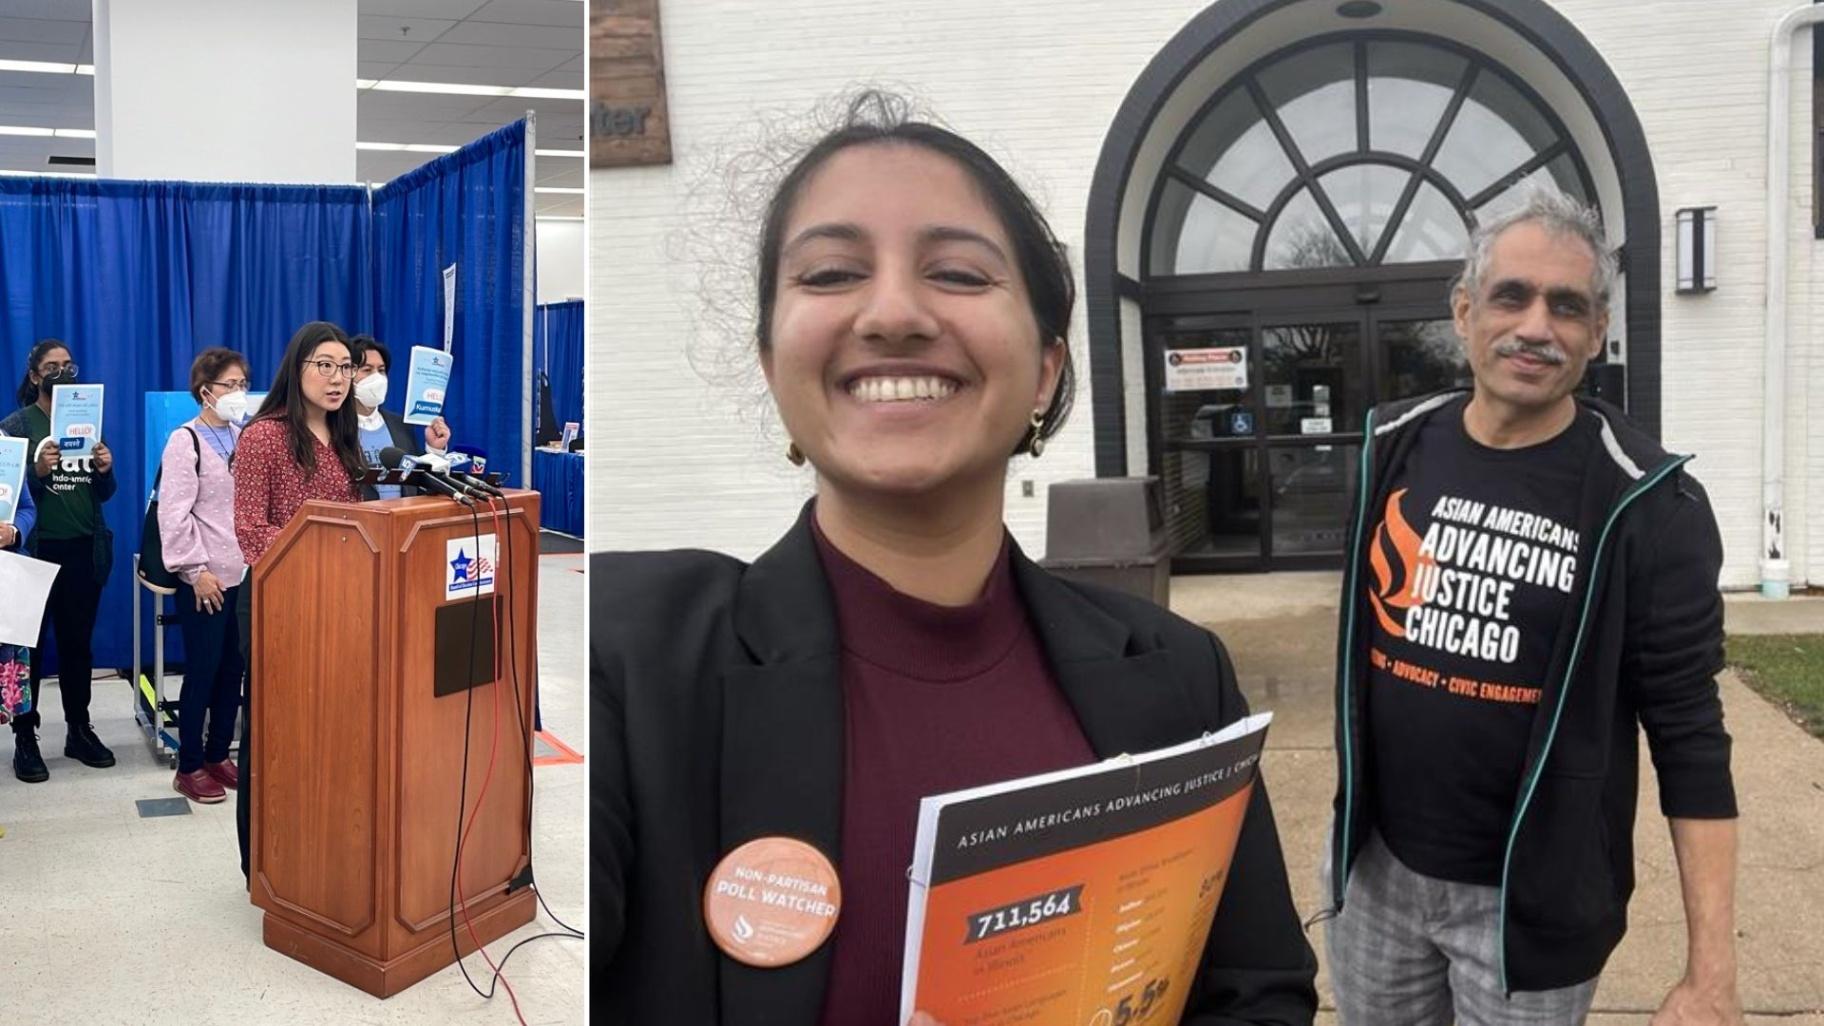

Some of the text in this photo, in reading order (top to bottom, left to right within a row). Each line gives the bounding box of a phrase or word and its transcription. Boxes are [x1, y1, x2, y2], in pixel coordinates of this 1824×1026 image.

[1431, 496, 1485, 525] ASIAN
[1418, 522, 1577, 593] ADVANCING
[1411, 563, 1515, 620] JUSTICE
[1405, 605, 1520, 663] CHICAGO
[1392, 660, 1440, 688] ADVOCACY
[1448, 676, 1478, 697] CIVIC
[957, 826, 1008, 849] ASIAN
[1013, 803, 1101, 836] AMERICANS
[1105, 783, 1182, 813] ADVANCING
[1184, 768, 1224, 794] JUSTICE
[716, 880, 837, 918] POLL WATCHER
[735, 867, 829, 897] NON-PARTISAN
[977, 892, 1071, 939] 711,564
